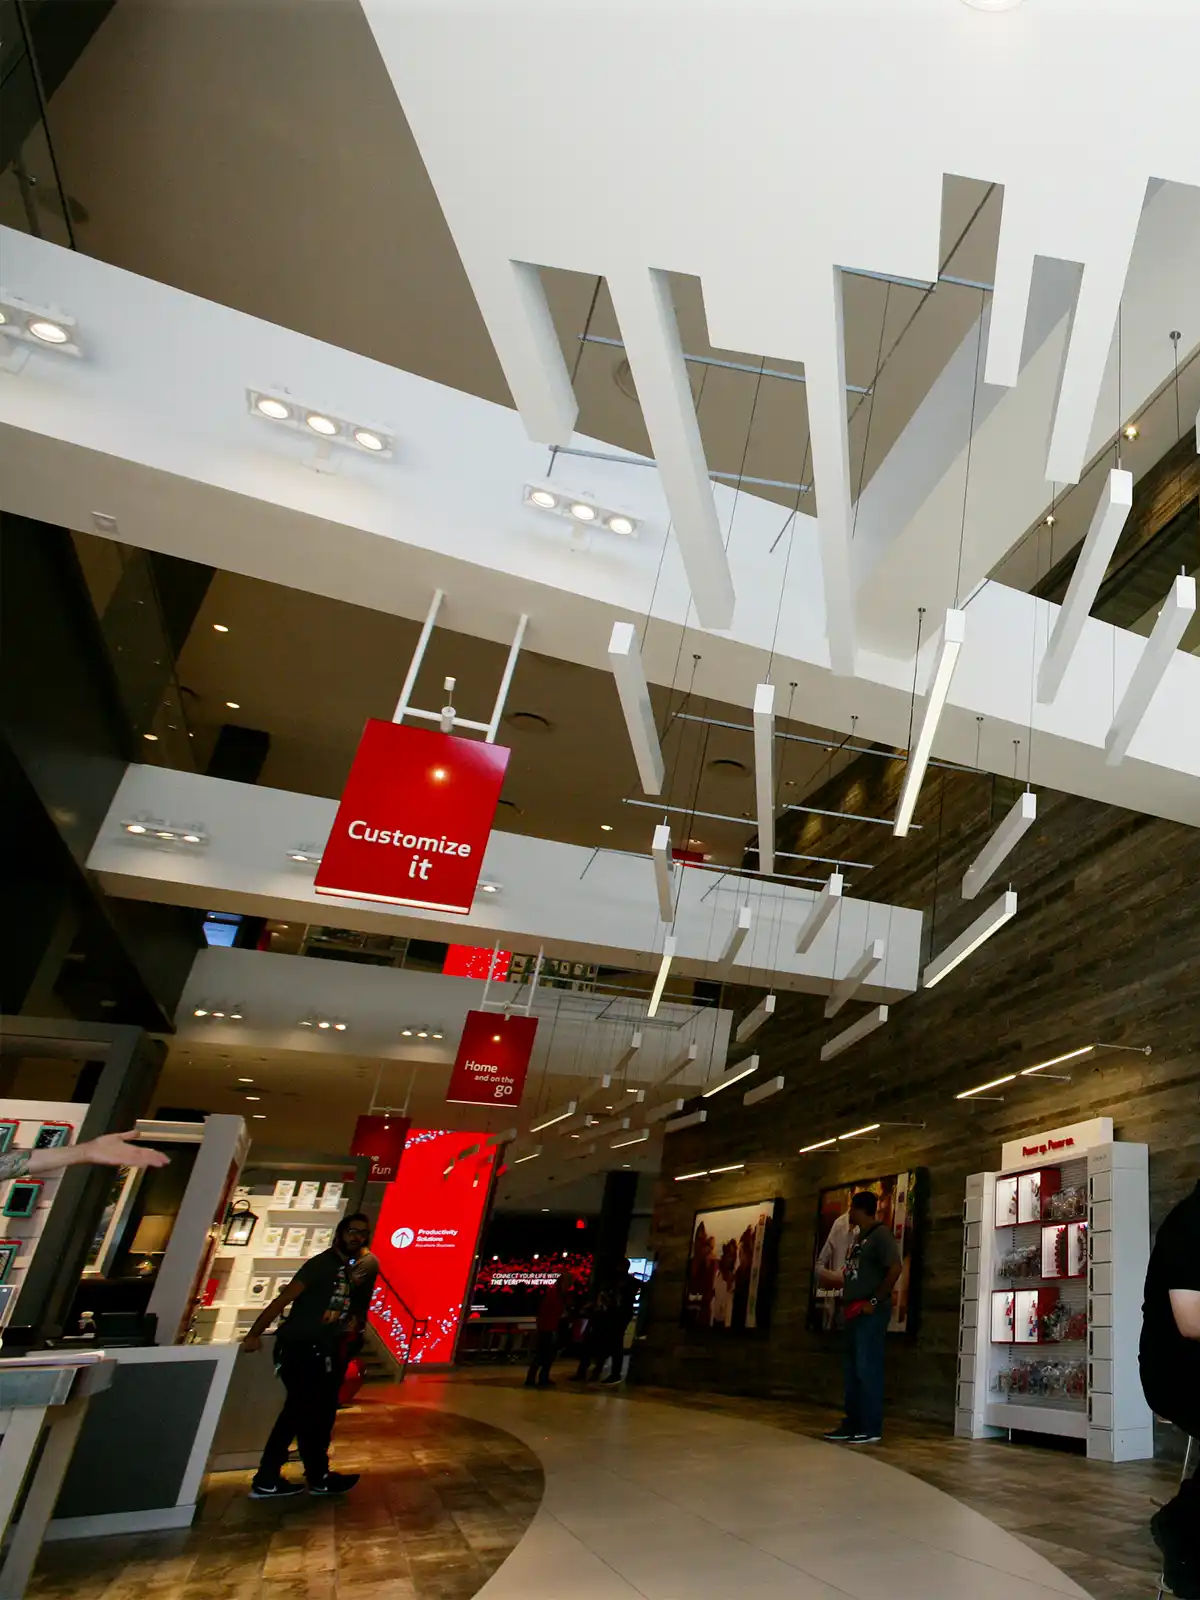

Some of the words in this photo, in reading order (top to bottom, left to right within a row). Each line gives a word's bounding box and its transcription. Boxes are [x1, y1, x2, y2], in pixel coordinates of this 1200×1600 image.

[348, 820, 471, 857] Customize
[408, 855, 433, 880] it
[464, 1060, 498, 1073] Home
[501, 1076, 514, 1084] the
[494, 1085, 513, 1098] go
[371, 1163, 391, 1175] fun
[417, 1228, 459, 1237] Productivity
[416, 1235, 444, 1243] Solutions
[490, 1278, 503, 1286] THE
